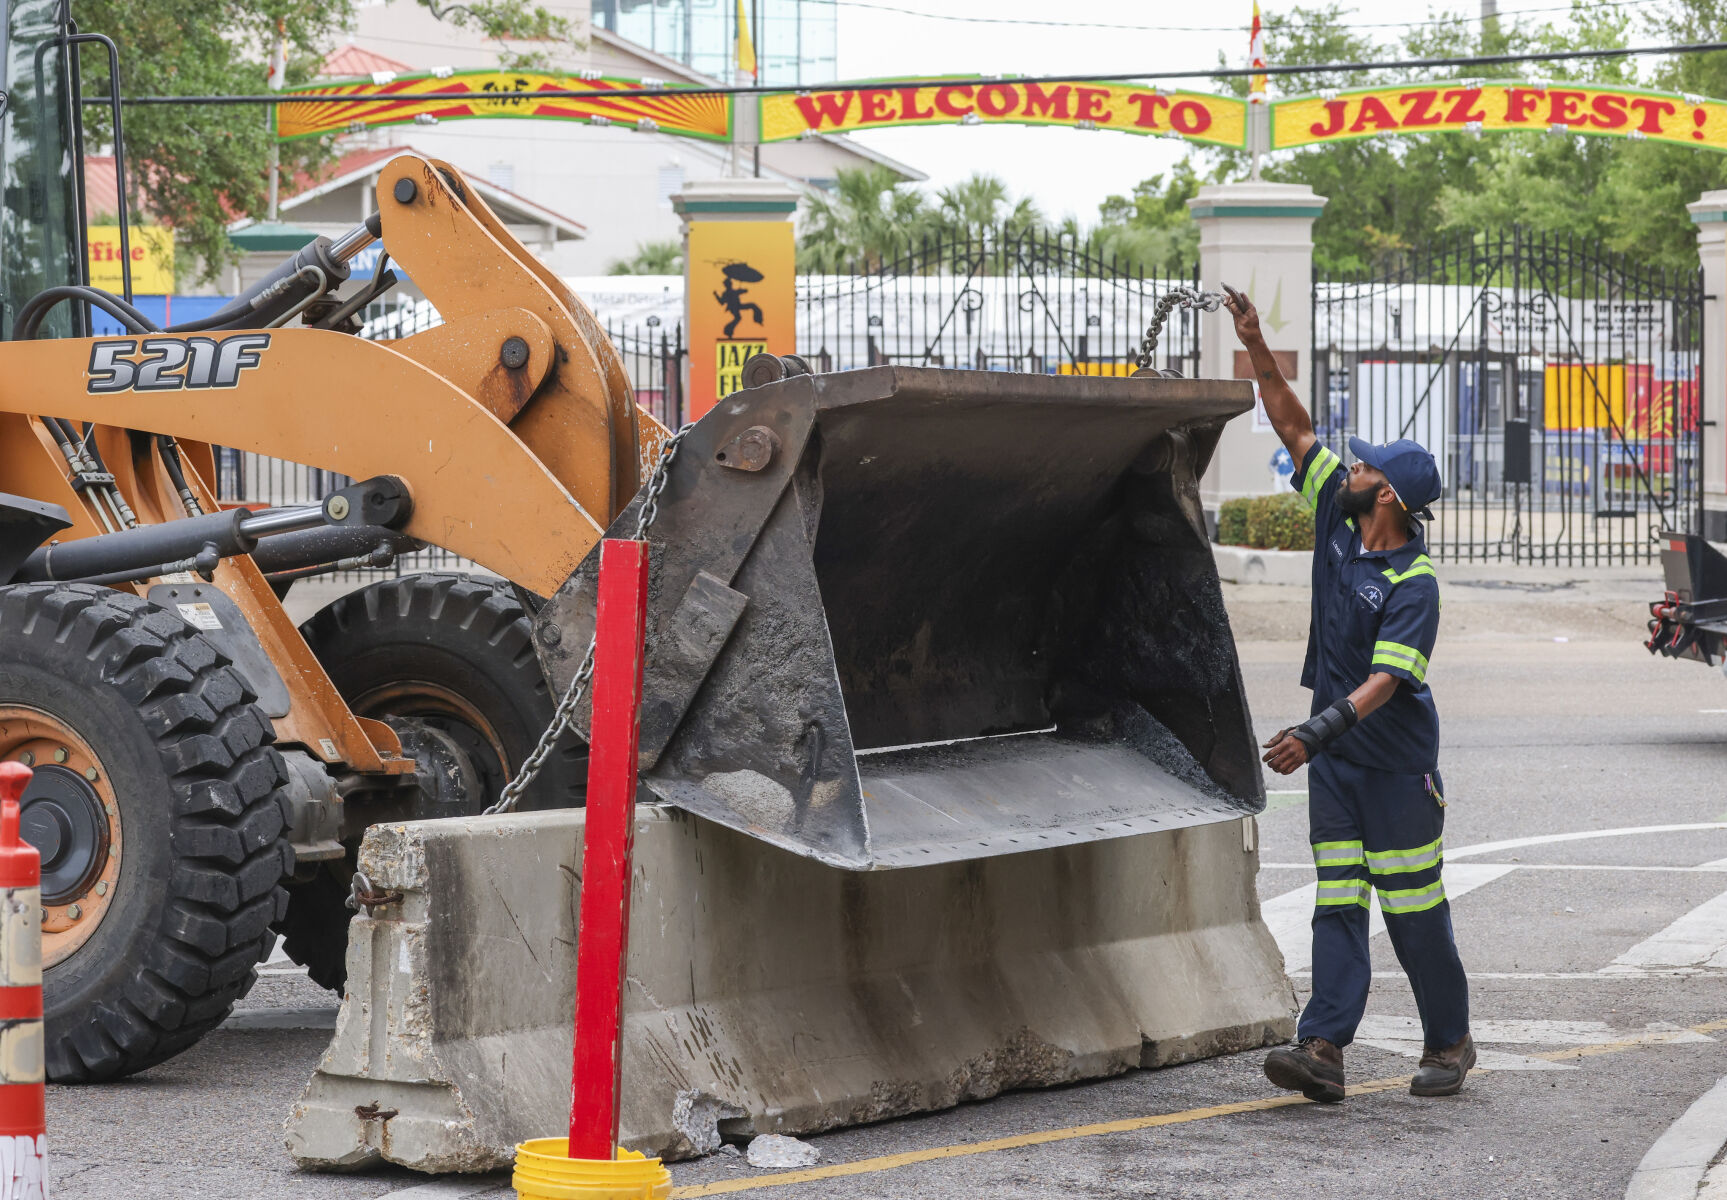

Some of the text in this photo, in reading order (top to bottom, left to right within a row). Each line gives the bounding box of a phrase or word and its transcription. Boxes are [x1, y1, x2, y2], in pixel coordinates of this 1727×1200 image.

[794, 82, 1111, 130] WELCOME
[1128, 93, 1212, 134] TO
[1310, 88, 1486, 136] JAZZ
[87, 333, 271, 394] 521F
